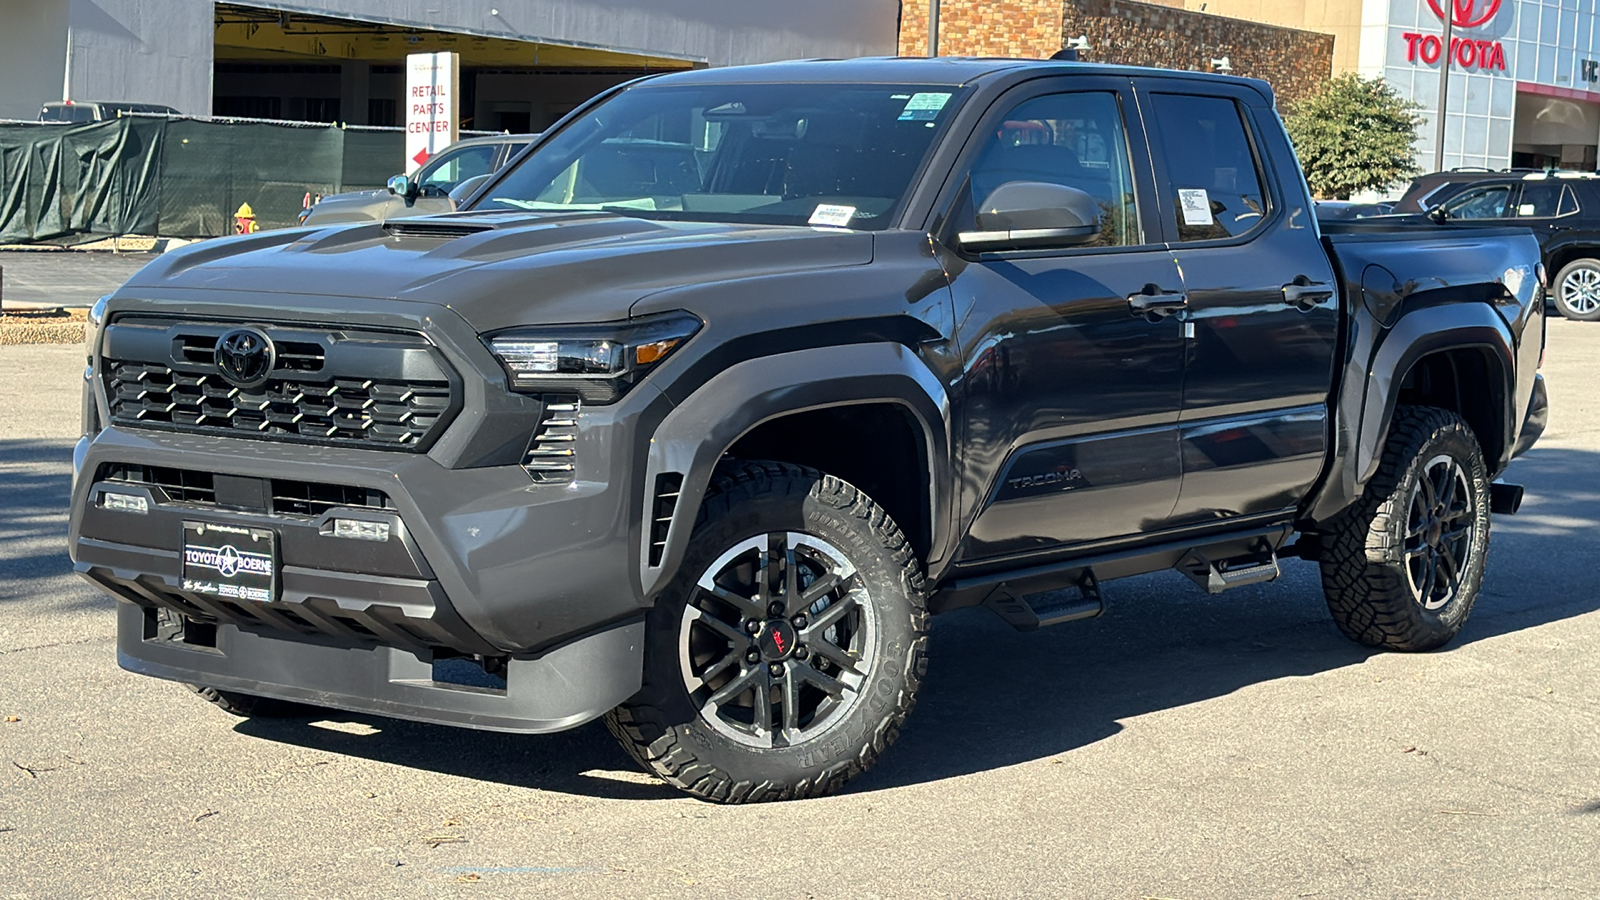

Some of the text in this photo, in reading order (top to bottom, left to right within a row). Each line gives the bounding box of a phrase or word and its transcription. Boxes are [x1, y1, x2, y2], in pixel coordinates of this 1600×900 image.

[412, 85, 446, 98] RETAIL
[413, 103, 444, 115] PARTS
[408, 121, 449, 133] CENTER
[1008, 468, 1081, 489] TACOMA
[185, 550, 271, 572] TOYOTA BOERNE
